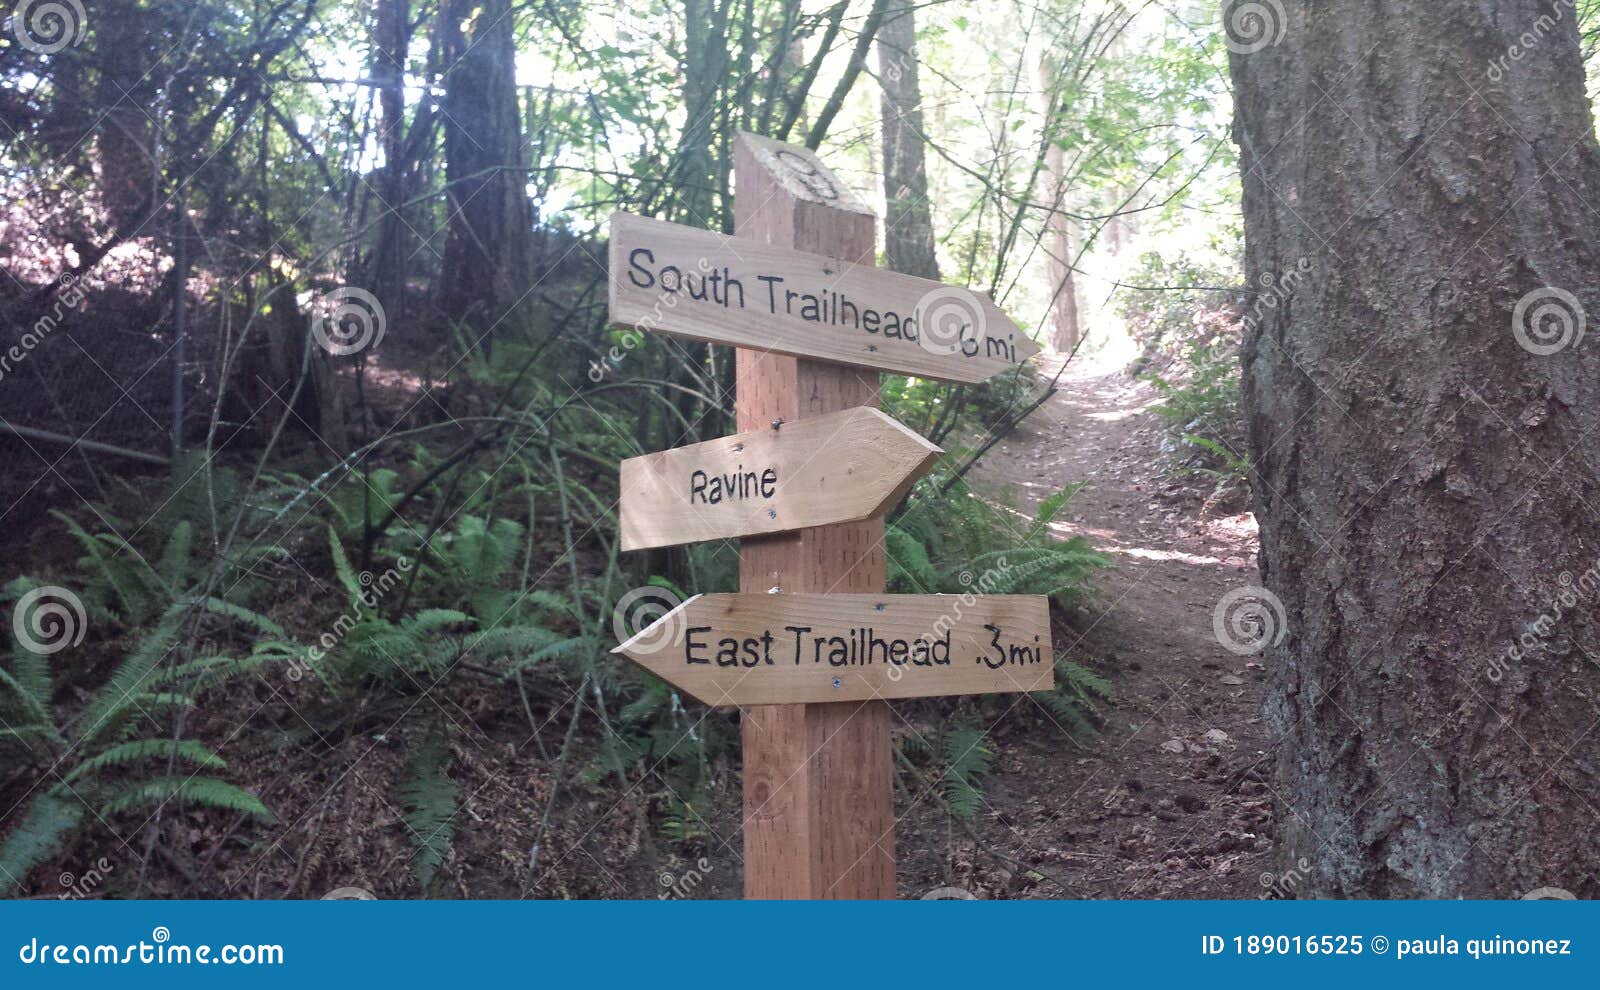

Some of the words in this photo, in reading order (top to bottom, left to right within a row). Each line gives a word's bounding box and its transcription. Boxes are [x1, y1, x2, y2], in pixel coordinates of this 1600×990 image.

[628, 248, 745, 308] South
[757, 274, 921, 346] Trailhead
[690, 465, 778, 505] Ravine
[685, 626, 775, 668] East
[785, 625, 951, 668] Trailhead
